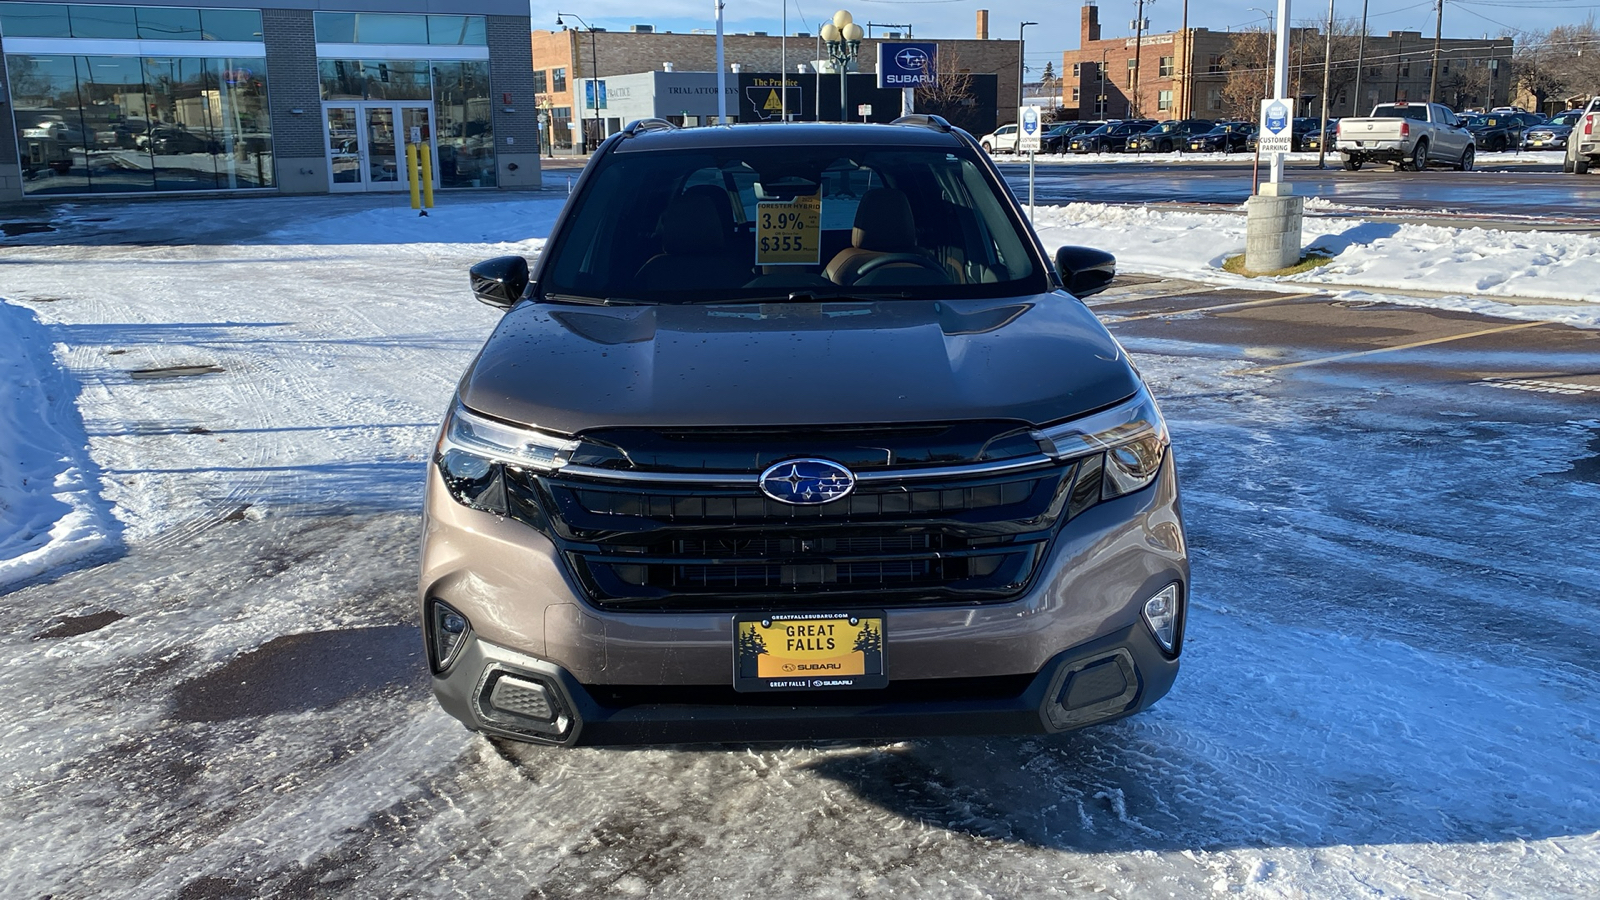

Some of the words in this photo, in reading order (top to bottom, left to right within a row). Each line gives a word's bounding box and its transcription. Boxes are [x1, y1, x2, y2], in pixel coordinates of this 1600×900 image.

[753, 78, 767, 86] The
[769, 78, 798, 86] Pratice
[886, 75, 934, 83] SUBARU
[762, 213, 804, 230] 3.9%
[760, 236, 802, 253] $355
[786, 624, 835, 637] GREAT
[787, 637, 836, 651] FALLS
[797, 663, 841, 671] SUBARU
